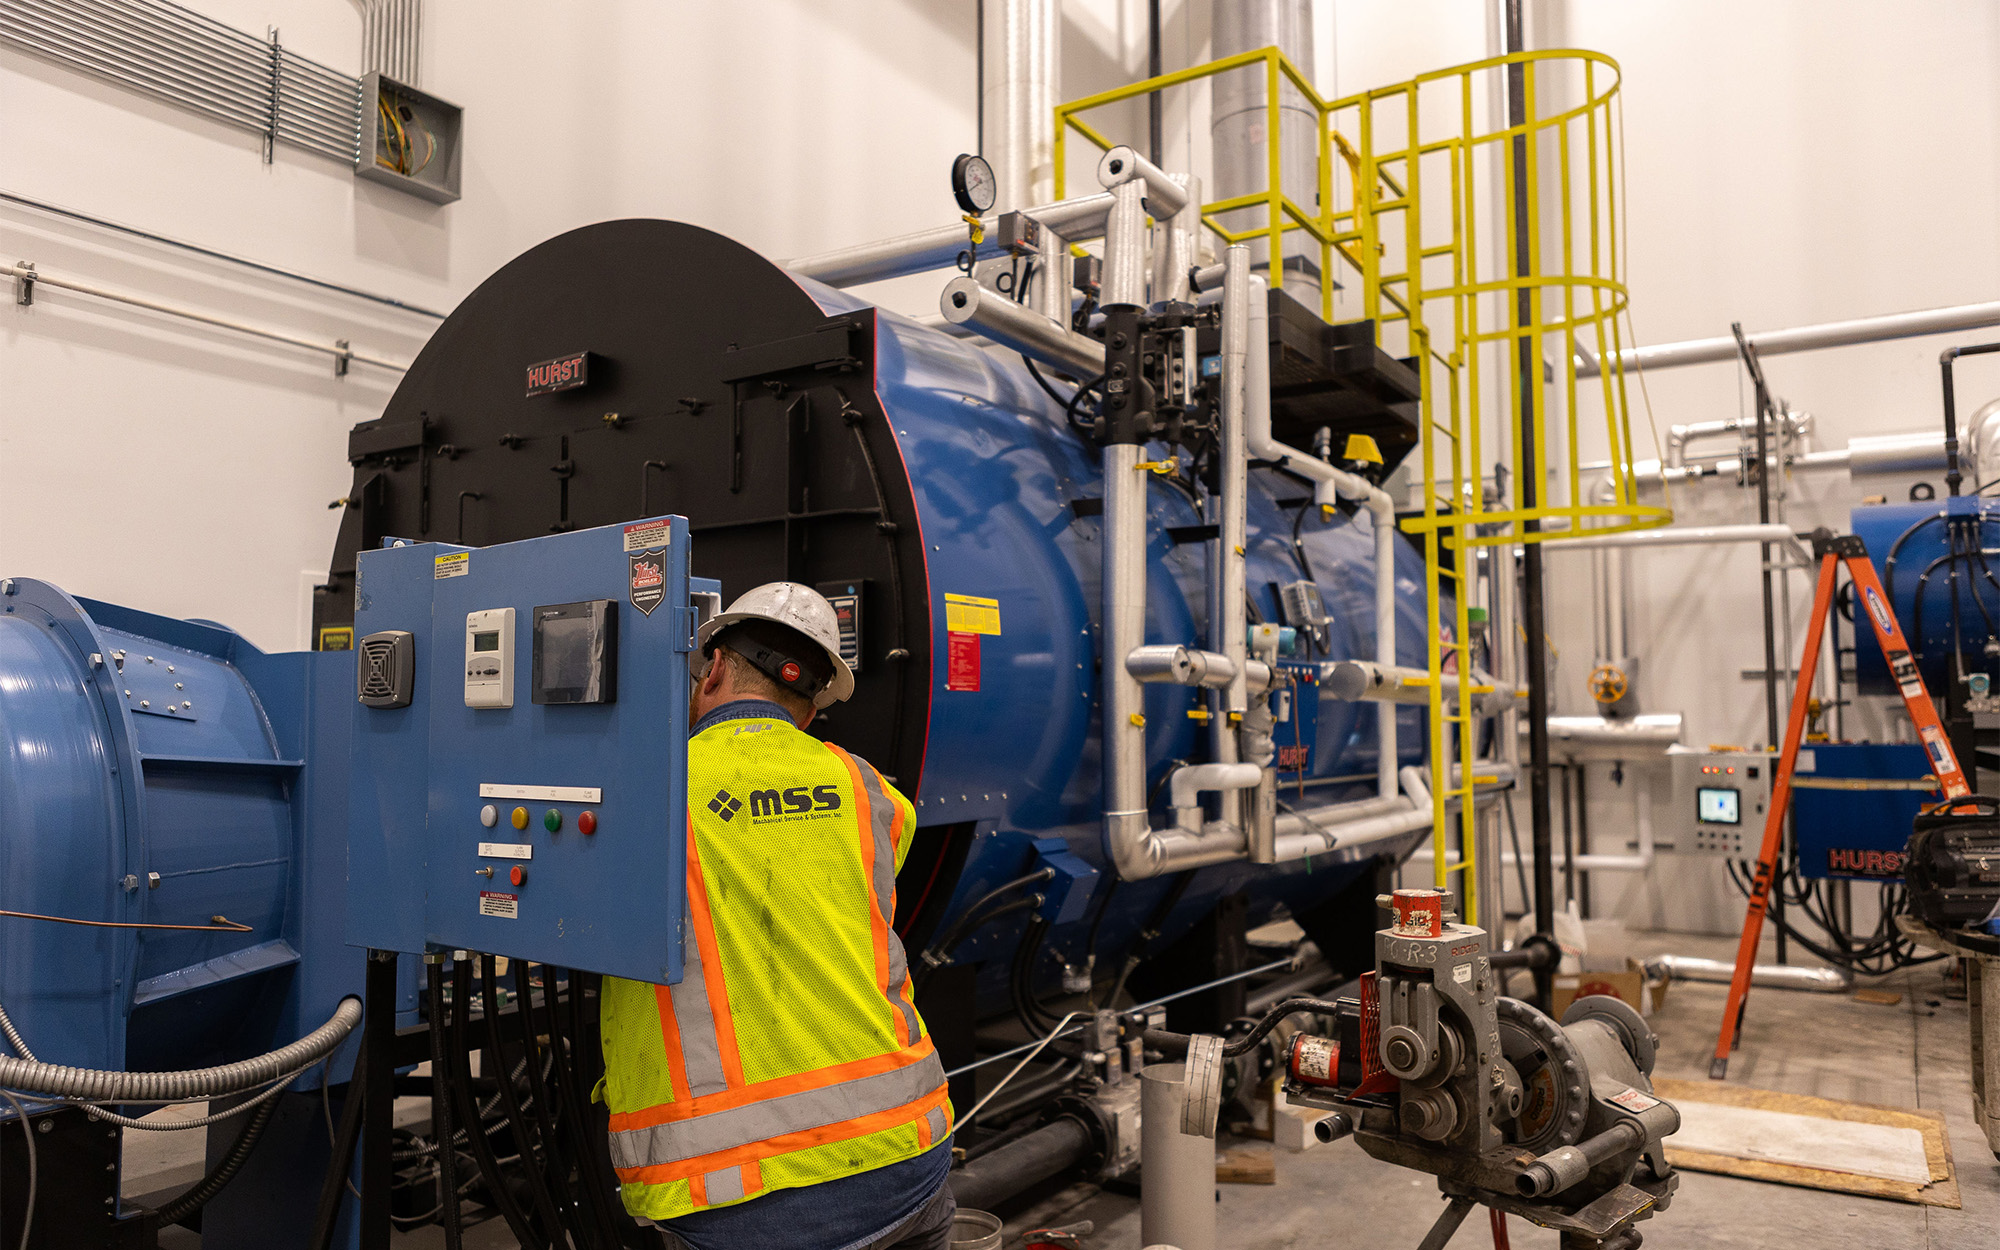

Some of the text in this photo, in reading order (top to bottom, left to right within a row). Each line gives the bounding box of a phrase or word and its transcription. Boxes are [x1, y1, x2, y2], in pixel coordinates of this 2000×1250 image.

[528, 358, 582, 389] HURST
[636, 521, 664, 531] WARNING
[1280, 748, 1308, 766] HURT
[1451, 942, 1480, 957] RIDGID
[1530, 1087, 1545, 1120] RIDGID
